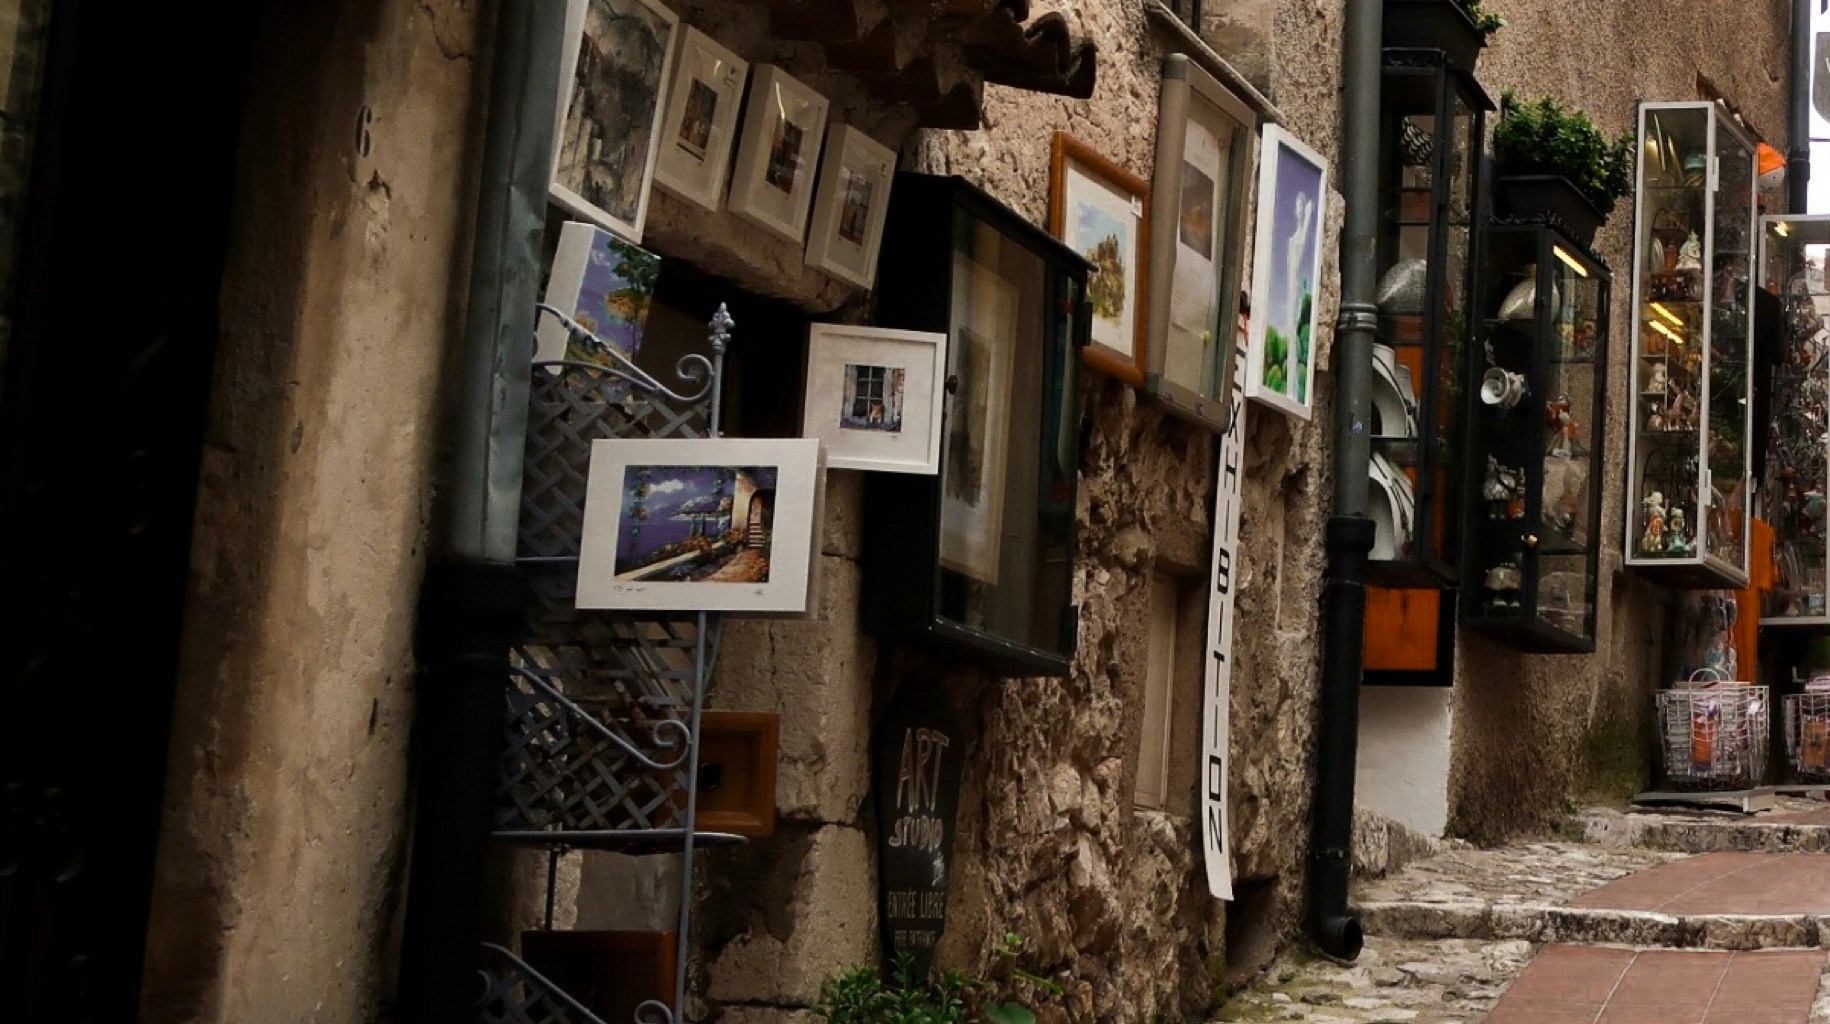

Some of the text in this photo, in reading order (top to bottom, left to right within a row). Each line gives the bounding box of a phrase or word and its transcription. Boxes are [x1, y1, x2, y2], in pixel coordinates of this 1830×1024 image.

[355, 105, 372, 158] 6
[896, 727, 950, 814] ART
[888, 815, 944, 853] STUDIO
[920, 891, 945, 919] LIBRE
